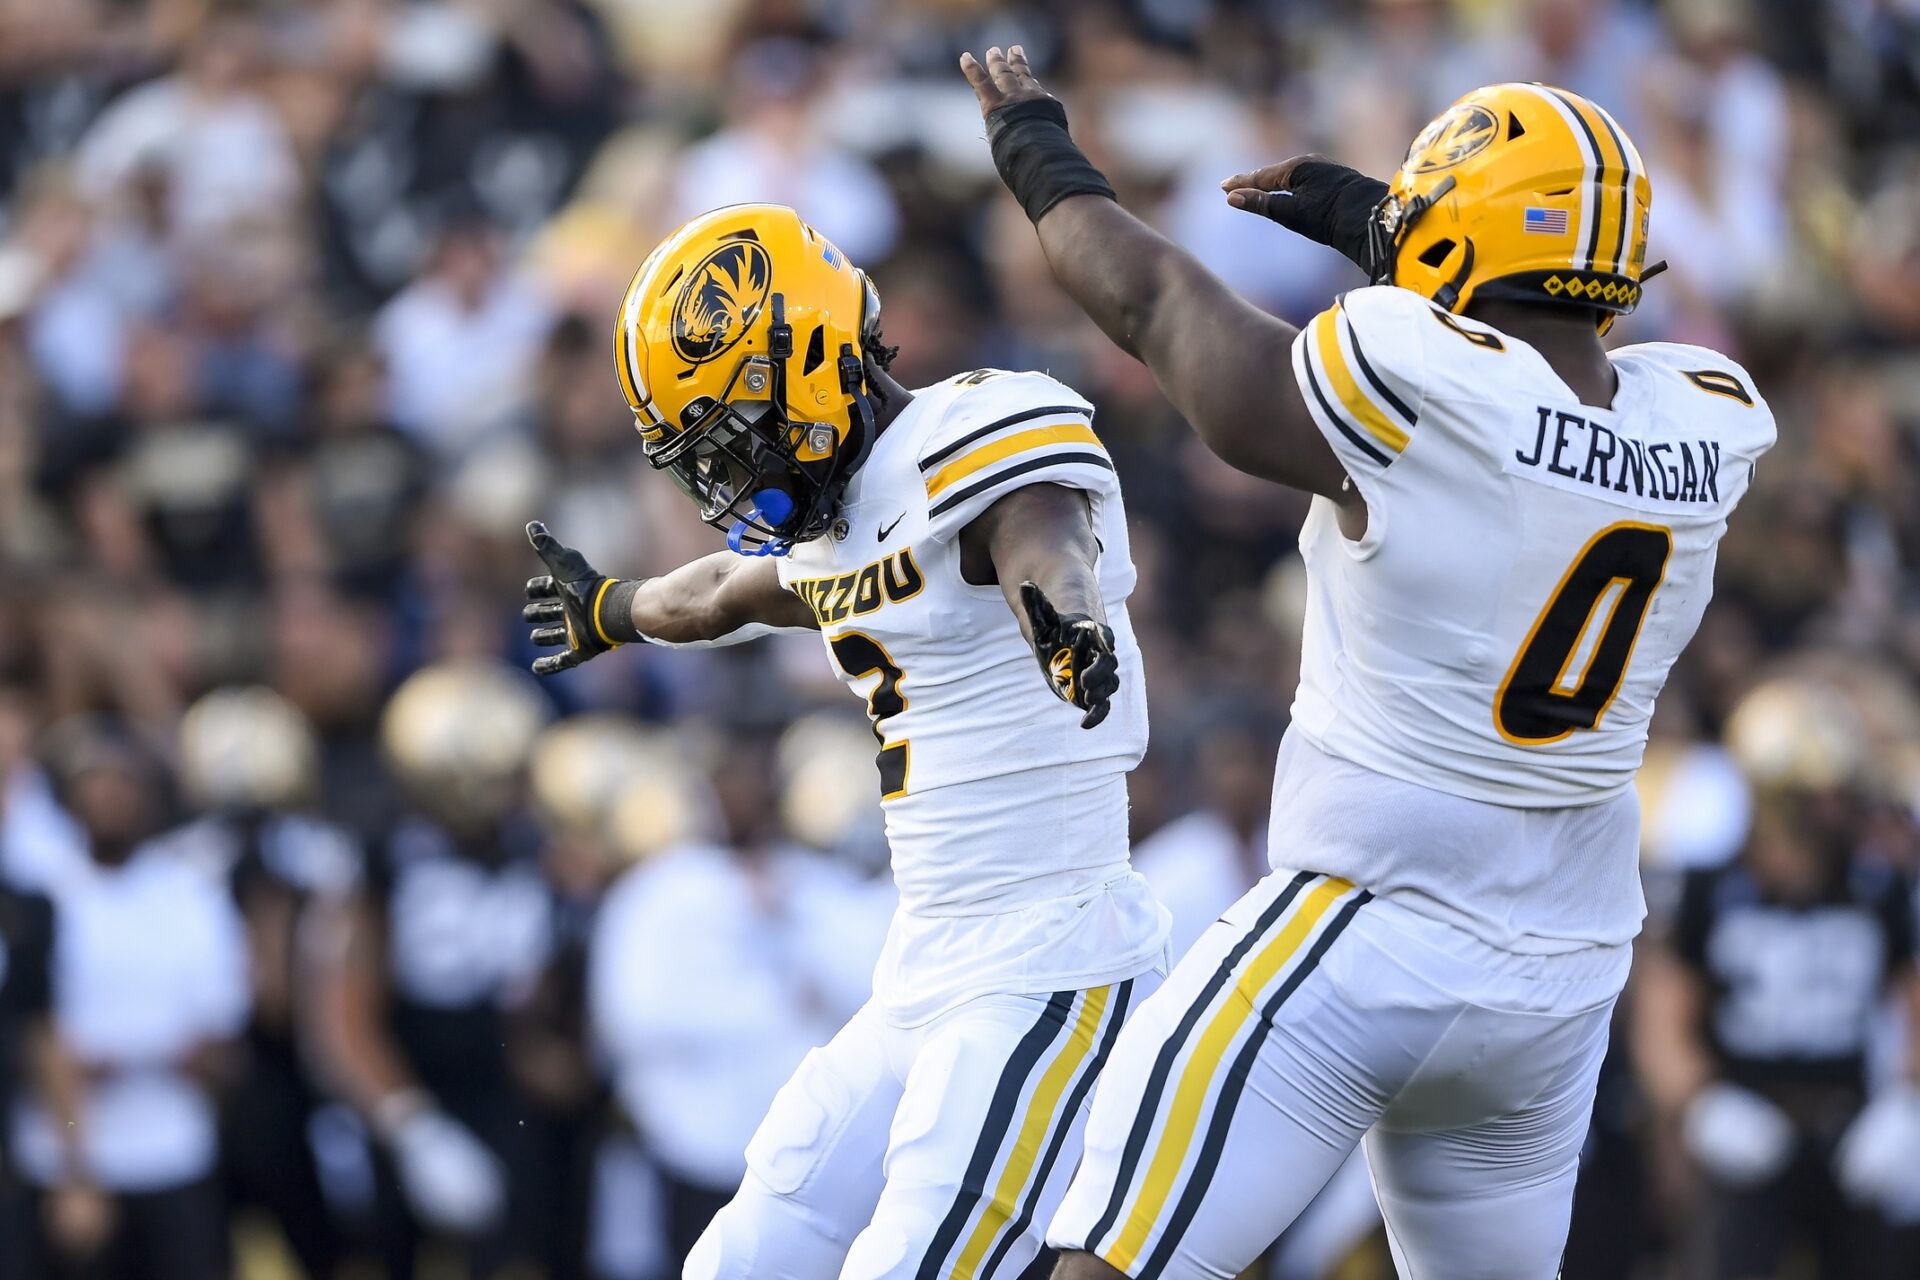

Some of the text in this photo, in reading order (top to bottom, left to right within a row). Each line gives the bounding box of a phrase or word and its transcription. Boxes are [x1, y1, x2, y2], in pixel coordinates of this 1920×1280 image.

[1515, 405, 1719, 504] JERNIGAN
[1678, 369, 1755, 409] 0
[1493, 521, 1672, 746] 0
[828, 629, 911, 801] 2
